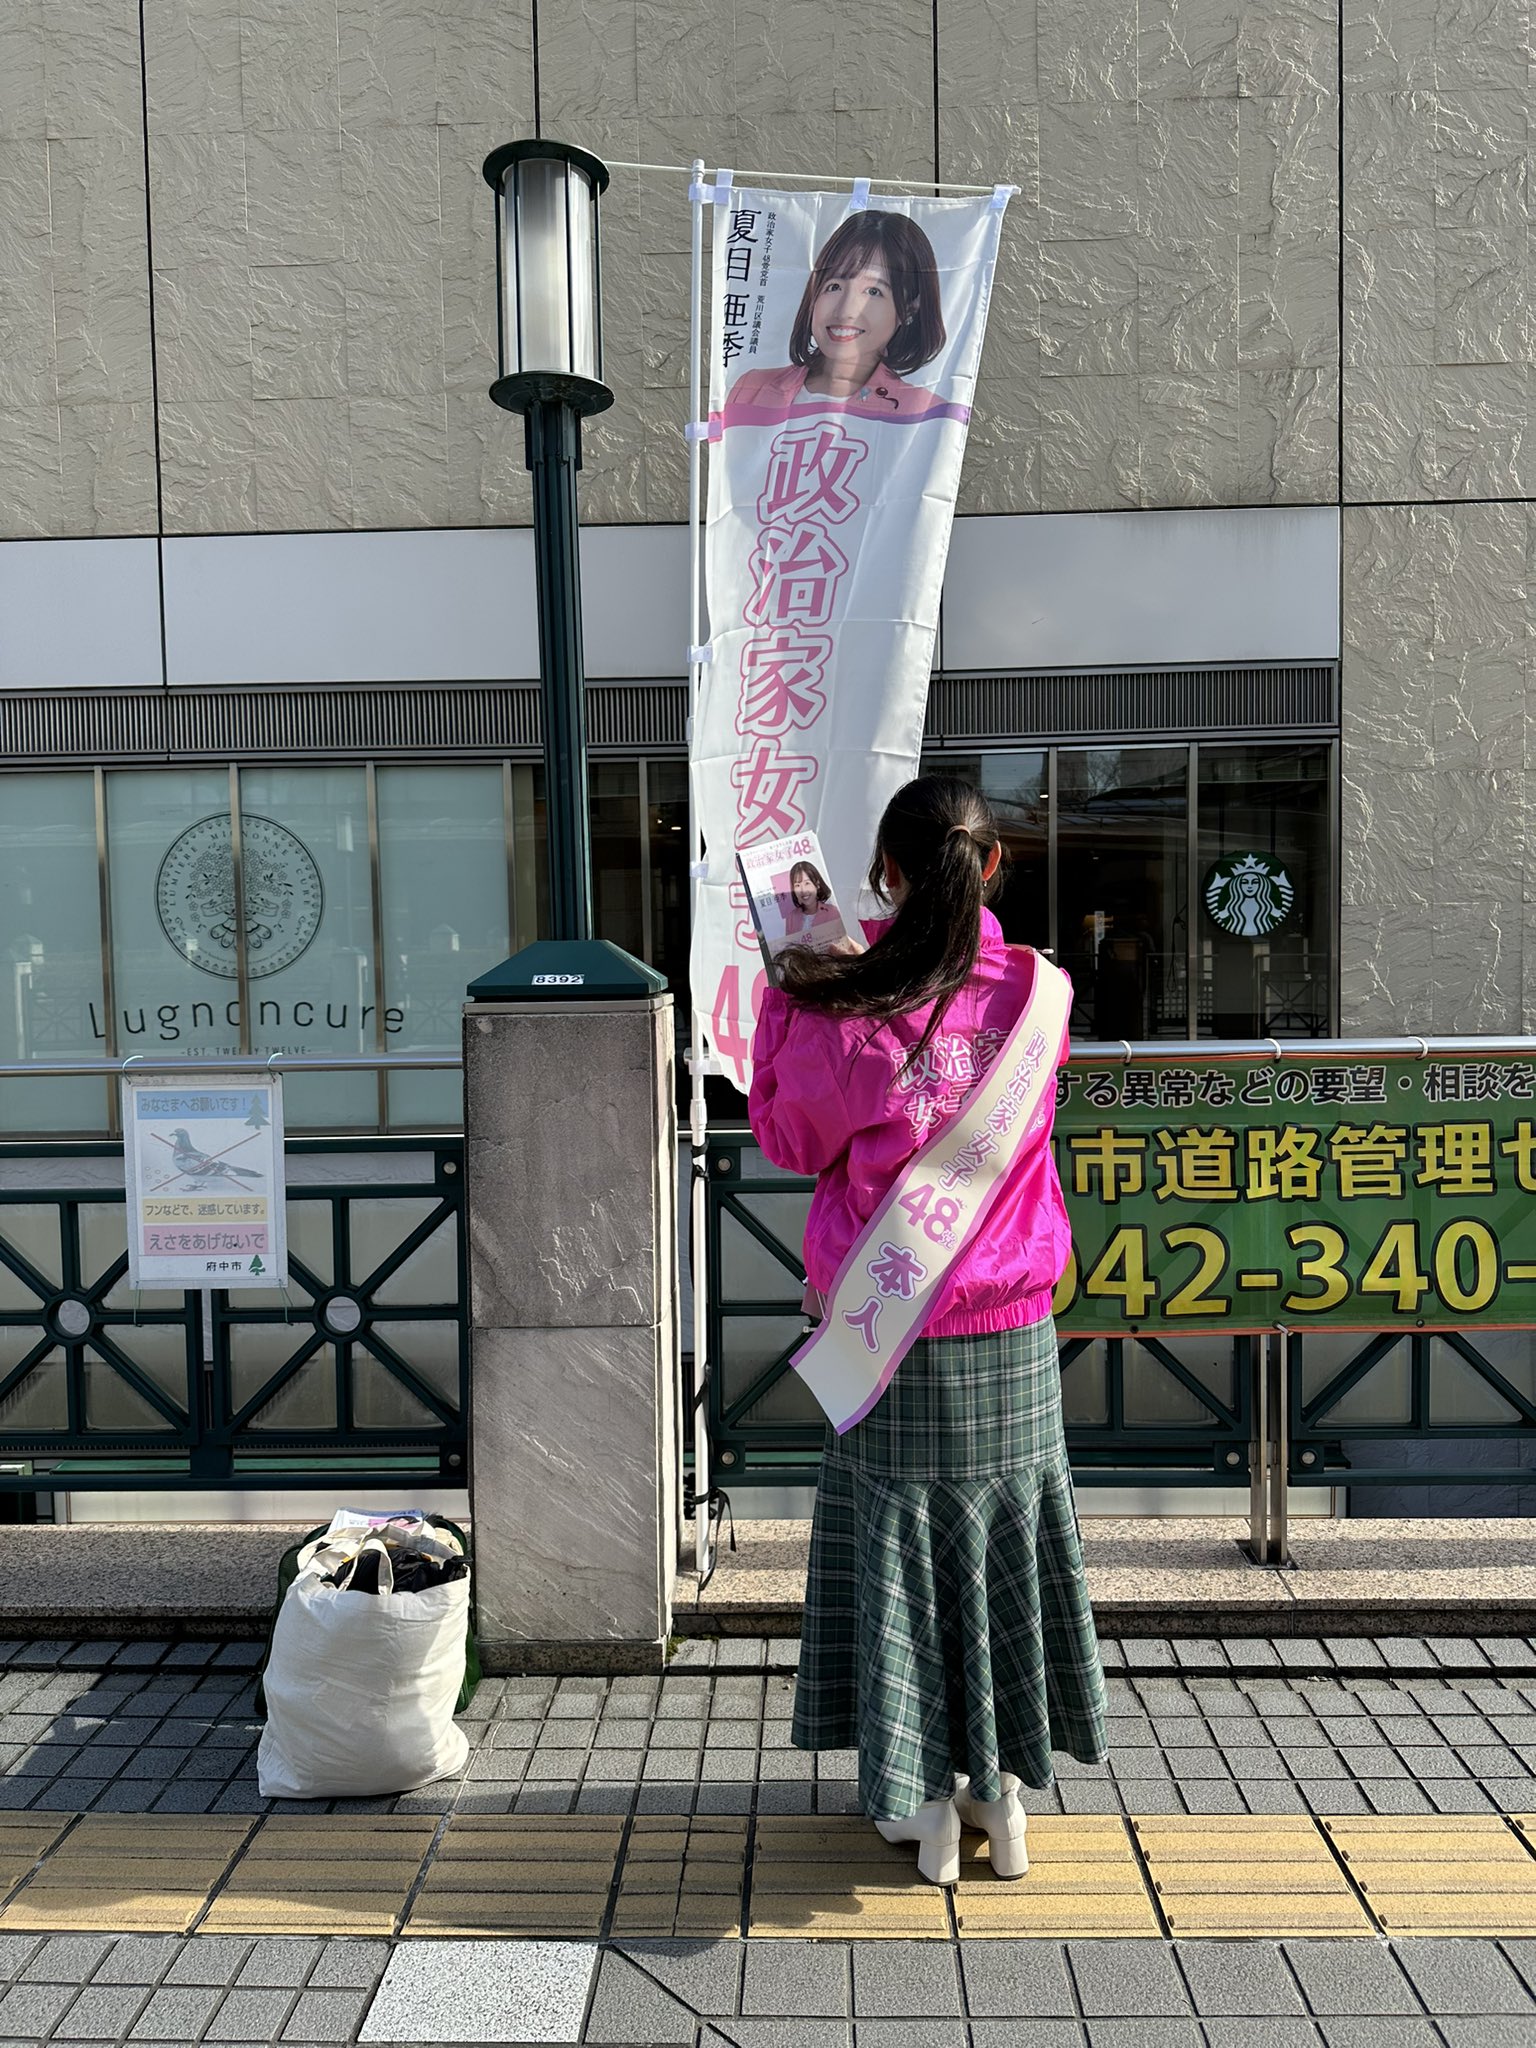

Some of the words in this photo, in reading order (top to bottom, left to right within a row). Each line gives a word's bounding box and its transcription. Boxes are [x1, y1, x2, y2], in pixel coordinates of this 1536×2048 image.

[169, 846, 199, 906] LUMIERE
[210, 831, 289, 856] MINONNE
[535, 975, 581, 984] 8392
[215, 1047, 259, 1056] TWEY
[1050, 1118, 1536, 1203] 市道路管理
[149, 1232, 265, 1250] えさをあげないで
[206, 1261, 243, 1272] 府中市
